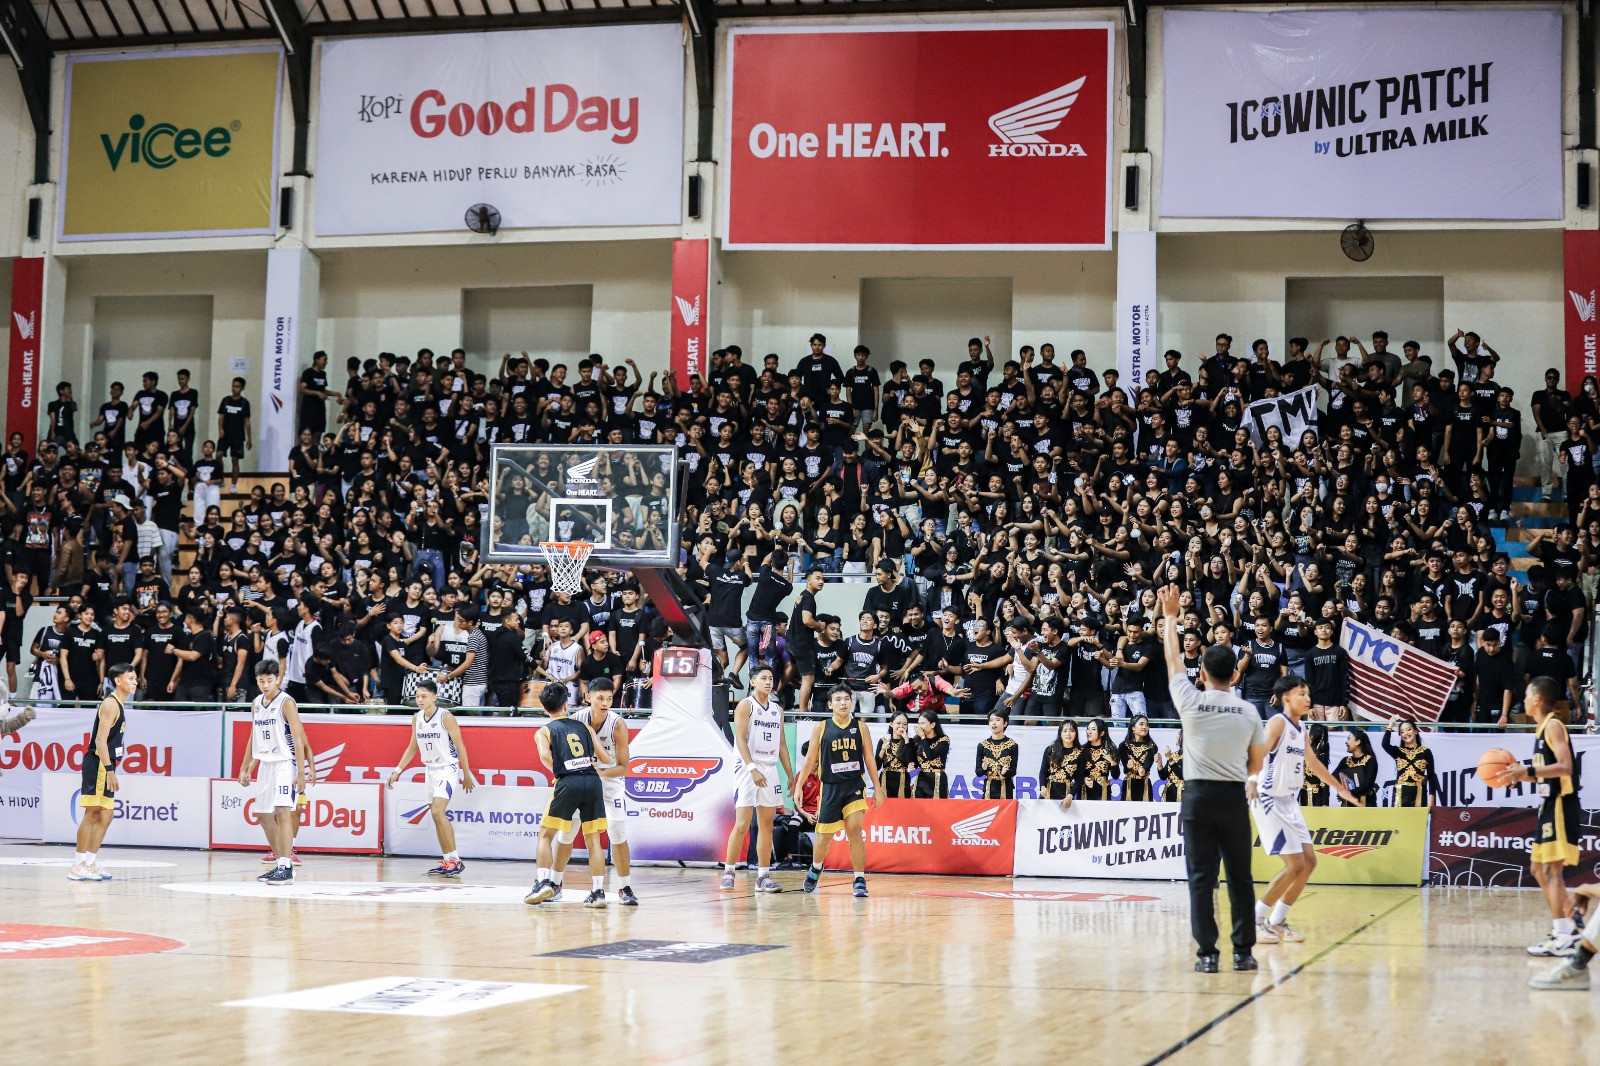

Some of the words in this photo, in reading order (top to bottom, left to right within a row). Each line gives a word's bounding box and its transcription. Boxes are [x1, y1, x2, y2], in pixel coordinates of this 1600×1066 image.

[1225, 80, 1372, 144] ICOWNIC
[1374, 61, 1495, 119] PATCH
[409, 86, 536, 138] Good
[543, 83, 639, 145] Day
[749, 122, 819, 159] One
[827, 122, 949, 158] HEART.
[1314, 141, 1330, 155] by
[1335, 126, 1417, 158] ULTRA
[1422, 114, 1489, 145] MILK
[988, 143, 1088, 157] HONDA
[371, 171, 428, 185] KARENA
[433, 167, 472, 182] HIDUP
[478, 167, 518, 181] PERLU
[524, 164, 576, 179] BANYAK
[585, 163, 618, 178] RASA
[1132, 304, 1141, 344] MOTOR
[275, 316, 284, 354] MOTOR
[1584, 333, 1597, 373] HEART.
[22, 349, 34, 385] HEART.
[273, 357, 283, 391] ASTRA
[1132, 348, 1141, 384] ASTRA
[21, 386, 32, 408] One
[566, 488, 578, 496] One
[578, 488, 598, 496] HEART.
[1346, 620, 1400, 673] TMC
[451, 654, 460, 664] 16
[664, 656, 693, 674] 15
[1198, 704, 1243, 714] REFEREE
[566, 733, 585, 757] 6
[762, 731, 772, 742] 12
[831, 737, 857, 752] SLUA
[425, 742, 433, 751] 17
[842, 750, 850, 762] 8
[646, 766, 698, 775] HONDA
[278, 785, 289, 795] 18
[646, 780, 671, 793] DBL
[773, 784, 783, 795] 12
[9, 796, 40, 808] HIDUP
[113, 799, 179, 822] Biznet
[614, 798, 622, 808] 6
[315, 799, 366, 836] Day
[445, 809, 485, 824] STRA
[649, 807, 674, 818] Good
[675, 808, 694, 821] Day
[488, 829, 514, 837] member
[870, 824, 933, 845] HEART.
[1133, 811, 1185, 843] PAT
[951, 838, 1001, 846] HONDA
[1091, 854, 1103, 864] by
[1105, 848, 1157, 867] ULTRA
[1160, 843, 1186, 860] MI
